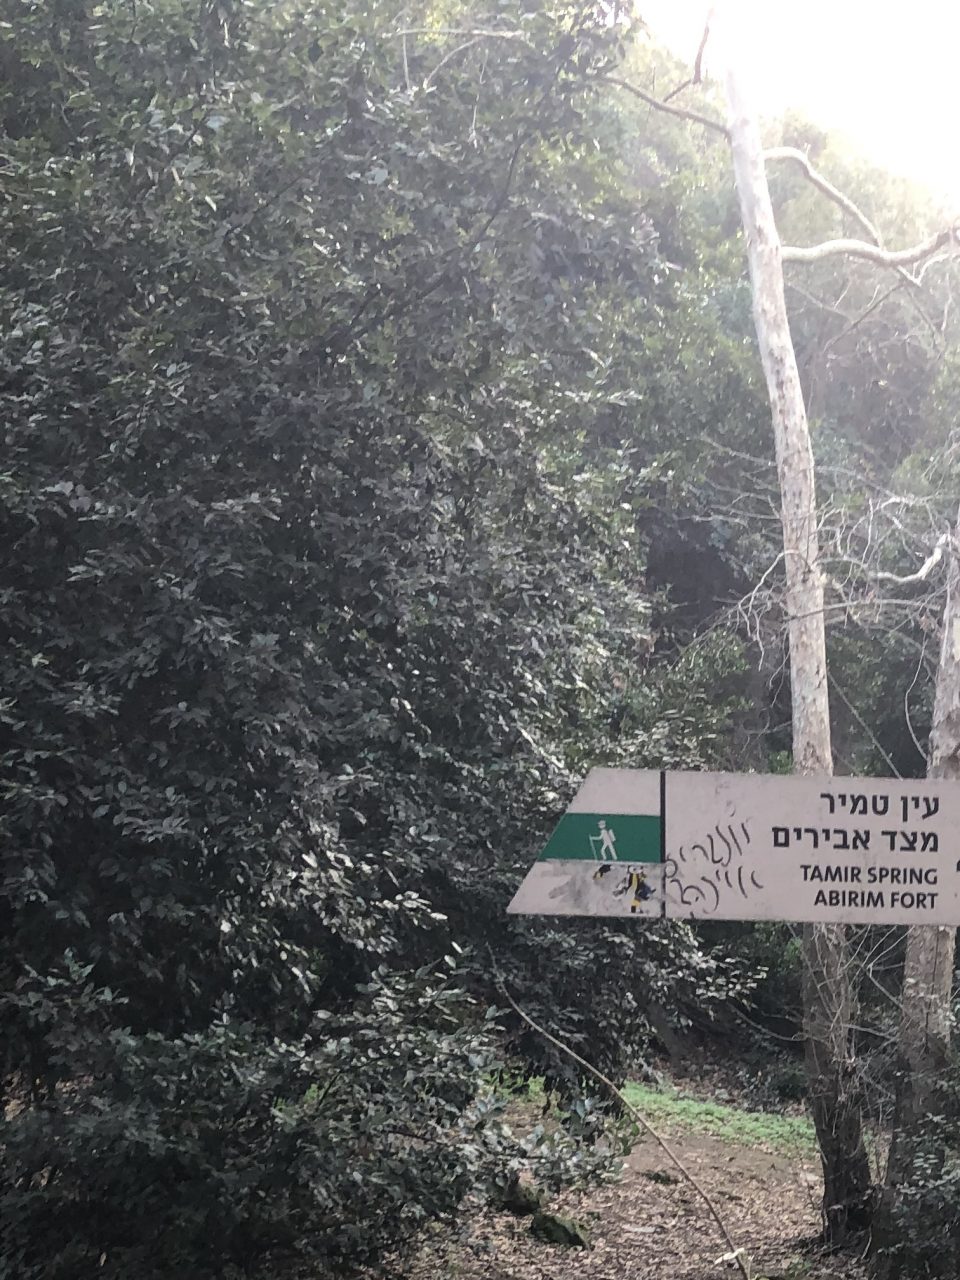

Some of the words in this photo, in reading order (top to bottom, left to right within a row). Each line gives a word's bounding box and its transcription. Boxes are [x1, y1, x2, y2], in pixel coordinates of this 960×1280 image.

[819, 793, 890, 816] טמיר
[900, 795, 940, 823] עין
[771, 826, 871, 850] אבירים
[881, 829, 939, 852] מצד
[799, 864, 862, 883] TAMIR
[867, 866, 938, 885] SPRING
[813, 889, 885, 908] ABIRIM
[890, 891, 939, 909] FORT
